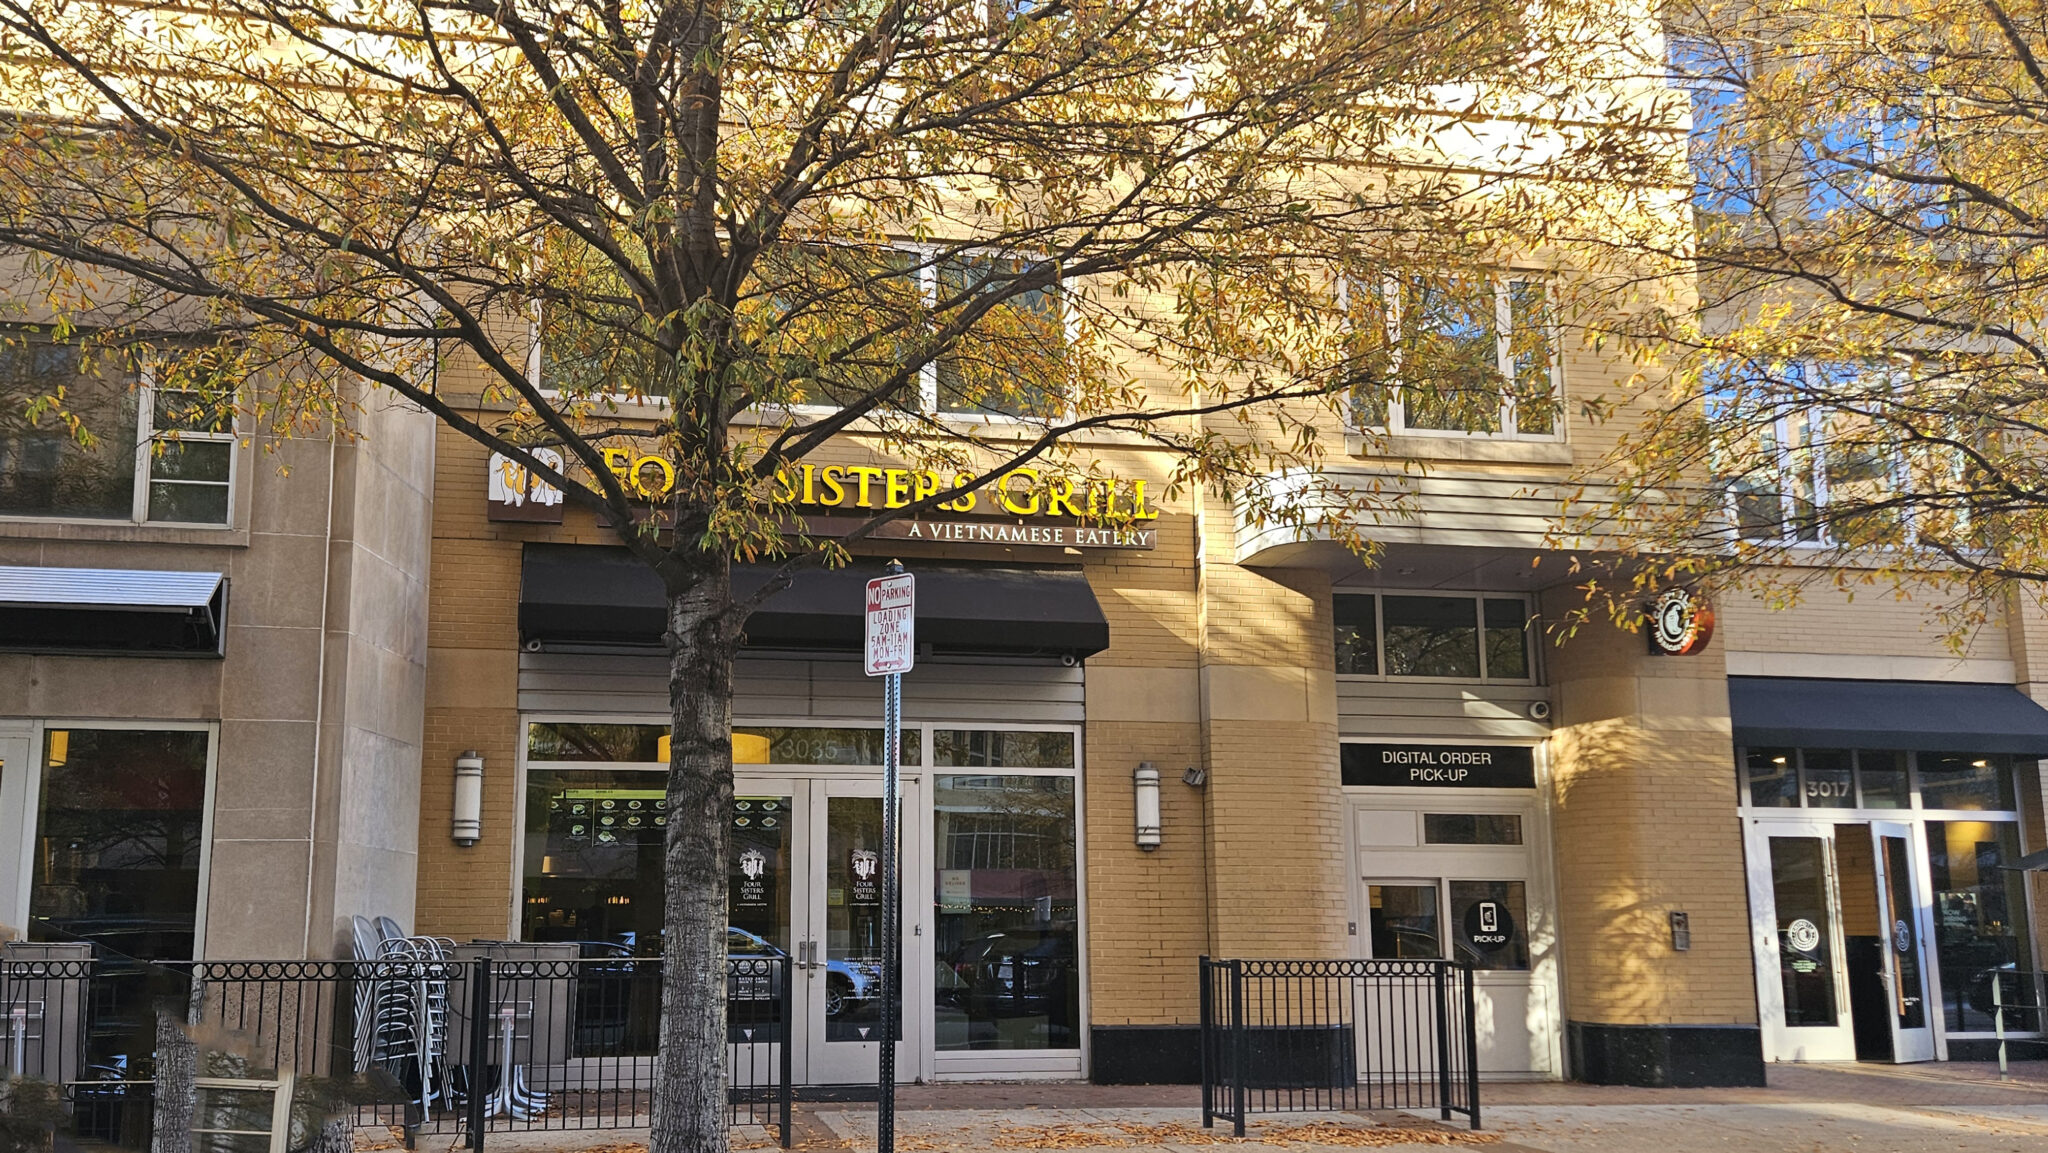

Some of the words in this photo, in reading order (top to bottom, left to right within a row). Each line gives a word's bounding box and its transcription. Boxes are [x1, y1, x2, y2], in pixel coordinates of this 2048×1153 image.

[772, 461, 977, 514] SISTERS
[998, 467, 1159, 520] GRILL
[908, 522, 922, 538] A
[928, 523, 1064, 543] VIETNAMESE
[1075, 528, 1150, 547] EATERY
[869, 587, 881, 605] NO
[882, 586, 910, 601] PARKING
[873, 608, 907, 625] LOADING
[879, 621, 900, 635] ZONE
[871, 634, 908, 648] 5AM-11AM
[873, 645, 906, 659] MON-FRI
[780, 737, 838, 760] 3035
[1381, 750, 1437, 764] DIGITAL
[1440, 751, 1492, 765] ORDER
[1410, 768, 1469, 782] PICK-UP
[1807, 781, 1850, 797] 3017
[743, 880, 762, 888] FOUR
[856, 880, 874, 888] FOUR
[1473, 935, 1506, 944] PICK-UP
